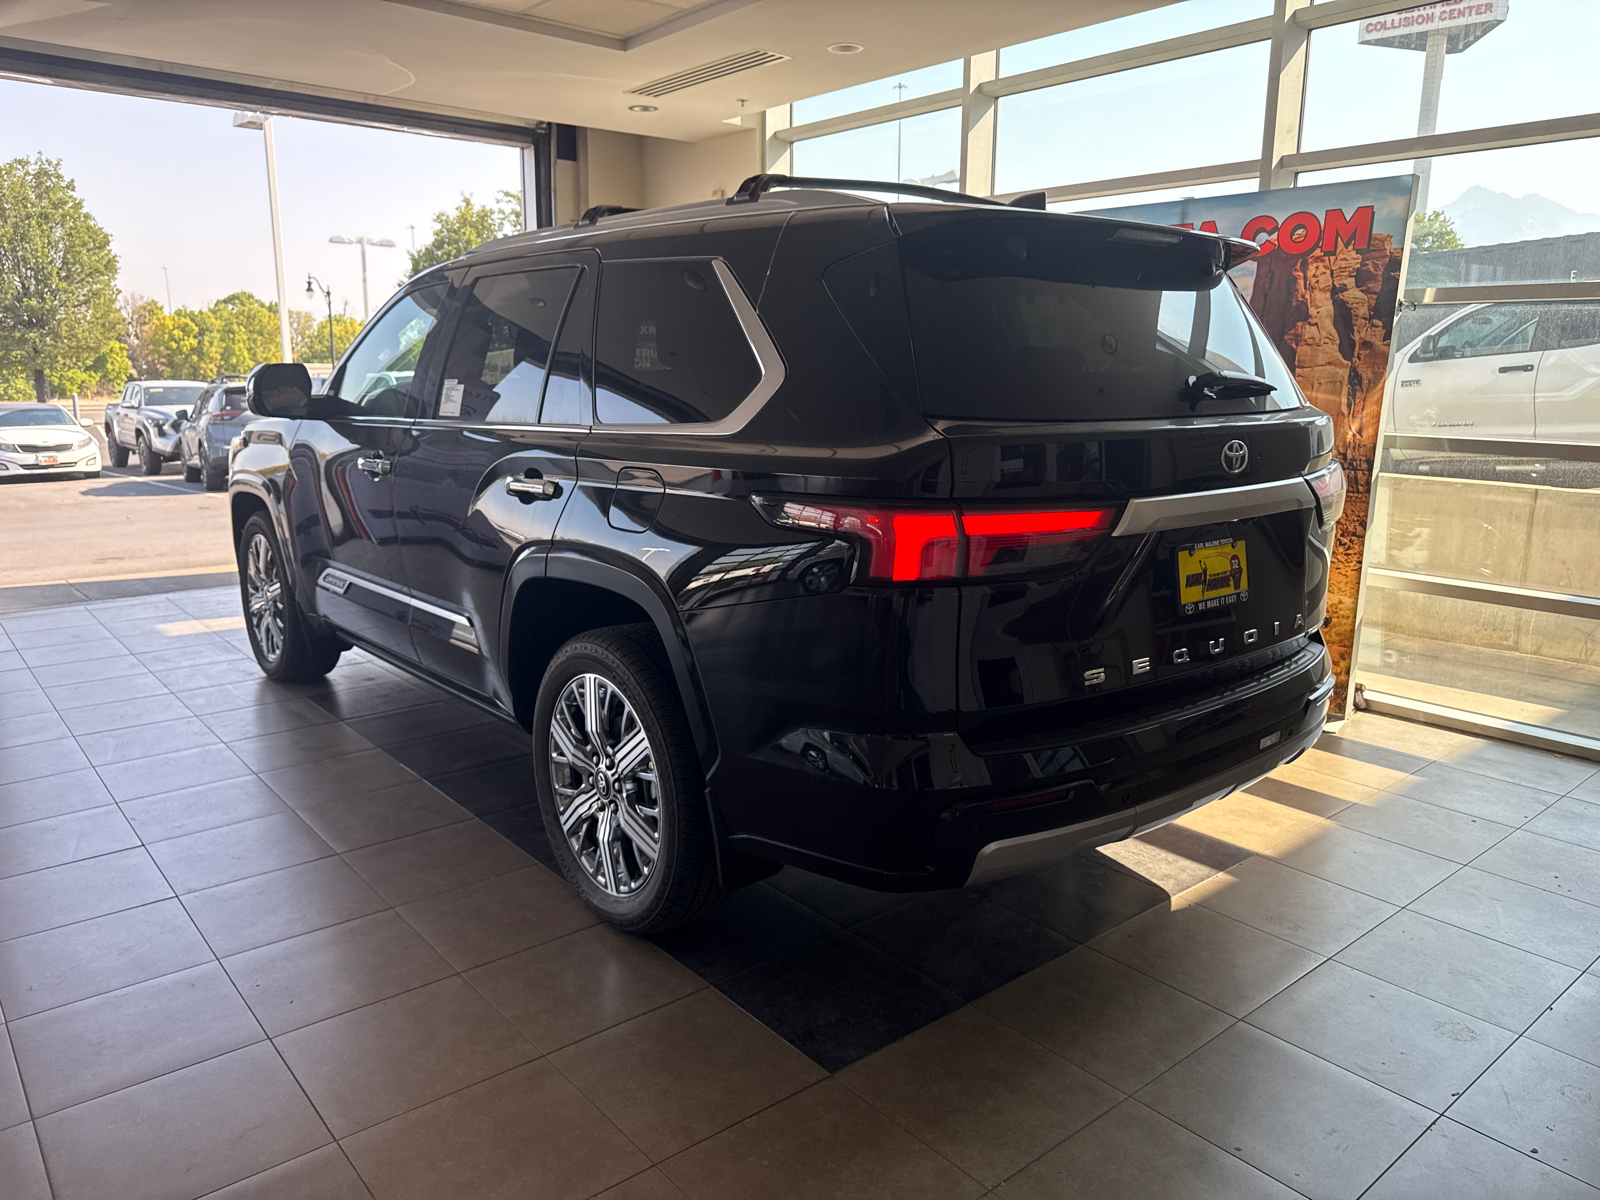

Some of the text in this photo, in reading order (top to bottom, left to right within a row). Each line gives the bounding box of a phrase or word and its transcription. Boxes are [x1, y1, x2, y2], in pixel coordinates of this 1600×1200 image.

[1365, 12, 1435, 34] COLLISION
[1438, 2, 1494, 22] CENTER
[1431, 420, 1474, 428] TUNDRA
[1205, 540, 1220, 548] MALONE
[1231, 559, 1239, 569] 32
[1206, 600, 1220, 608] MAKE
[1226, 594, 1237, 603] EASY
[1083, 613, 1305, 686] SEQUOIA
